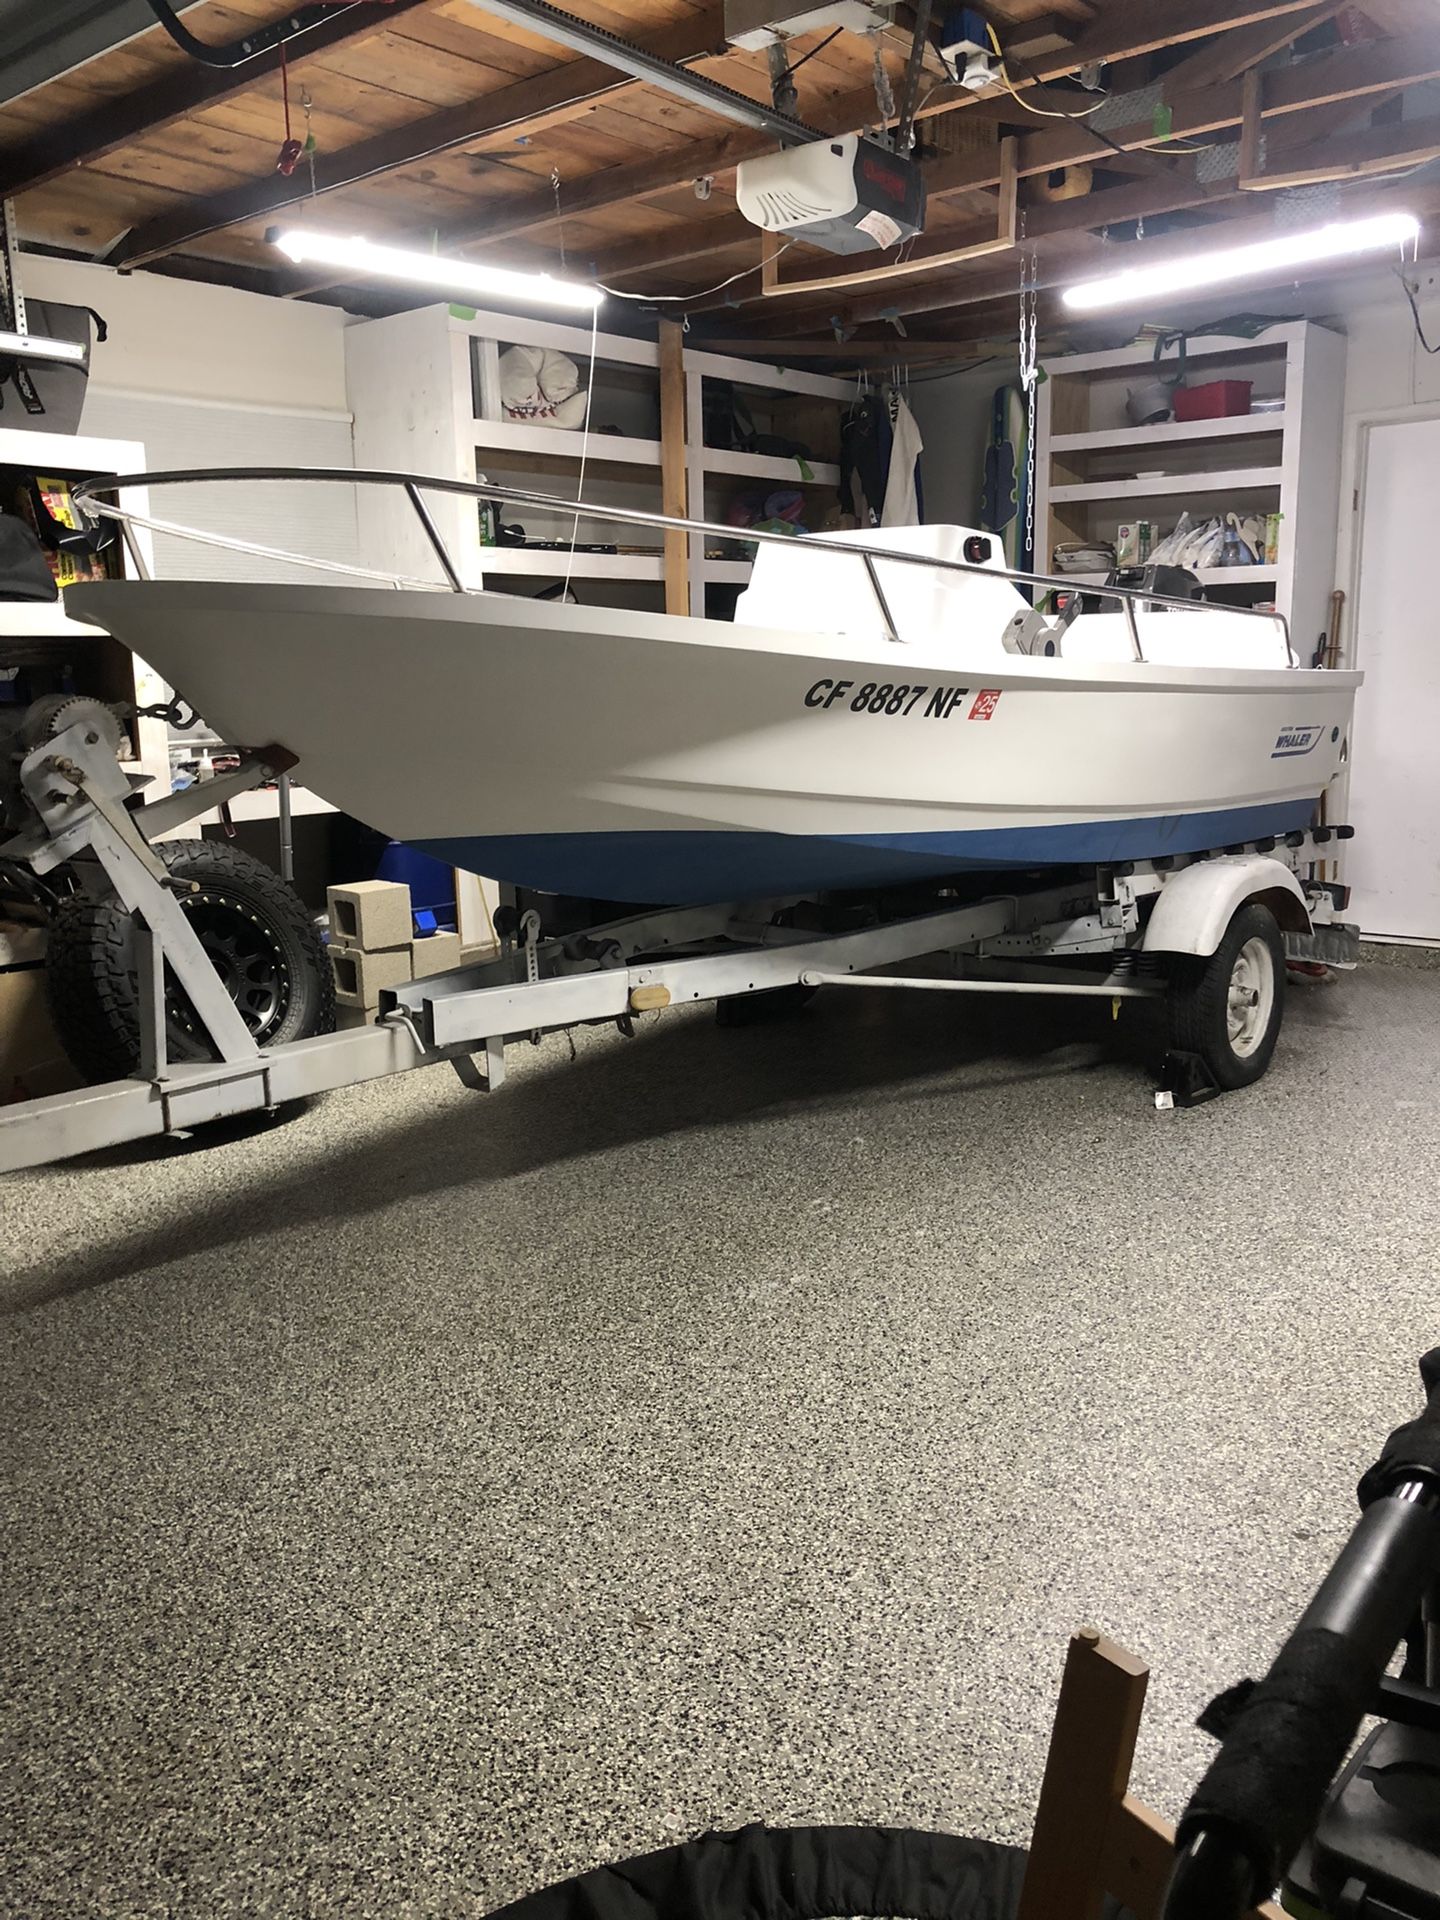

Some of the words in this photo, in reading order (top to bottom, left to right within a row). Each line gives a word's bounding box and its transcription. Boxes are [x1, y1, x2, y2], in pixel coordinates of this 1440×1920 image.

[804, 678, 854, 709] CF
[850, 683, 928, 716] 8887
[923, 687, 970, 719] NF
[978, 695, 998, 714] 25
[1275, 733, 1312, 749] WHALER
